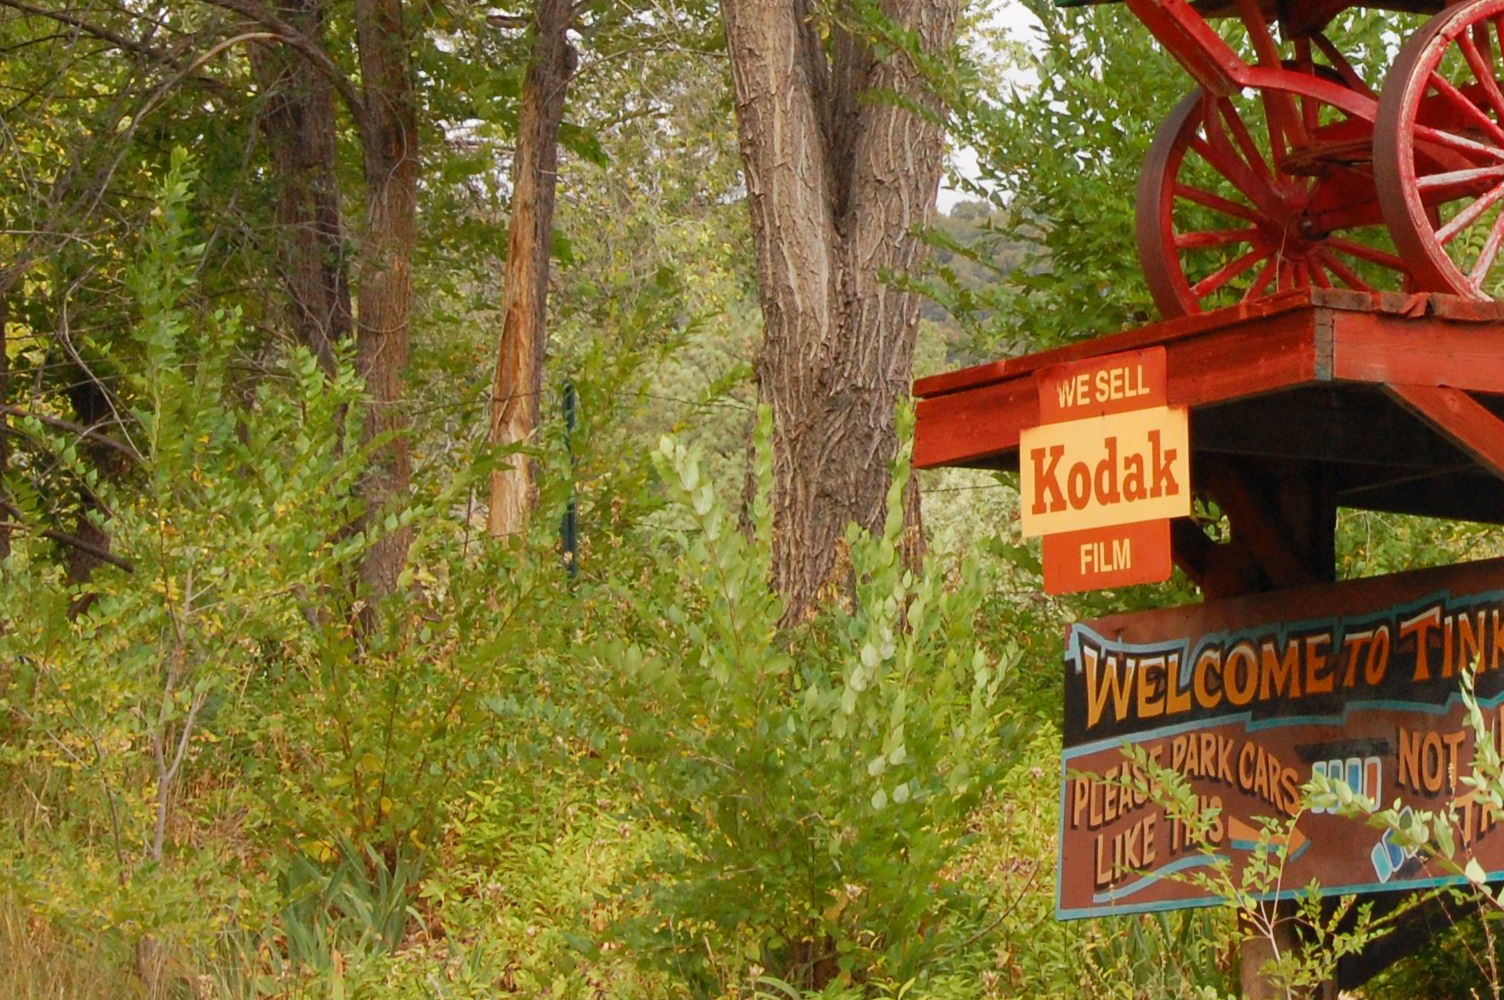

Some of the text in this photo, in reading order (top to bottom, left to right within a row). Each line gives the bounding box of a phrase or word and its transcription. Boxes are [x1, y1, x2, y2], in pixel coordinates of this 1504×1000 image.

[1057, 365, 1150, 409] WE SELL
[1030, 429, 1179, 515] Kodak
[1080, 538, 1131, 575] FILM
[1083, 633, 1335, 730] WELCOME
[1342, 625, 1390, 687] TO
[1172, 732, 1234, 784] PARK
[1238, 741, 1302, 817] CARS
[1398, 727, 1467, 792] NOT
[1097, 812, 1158, 885] LIKE
